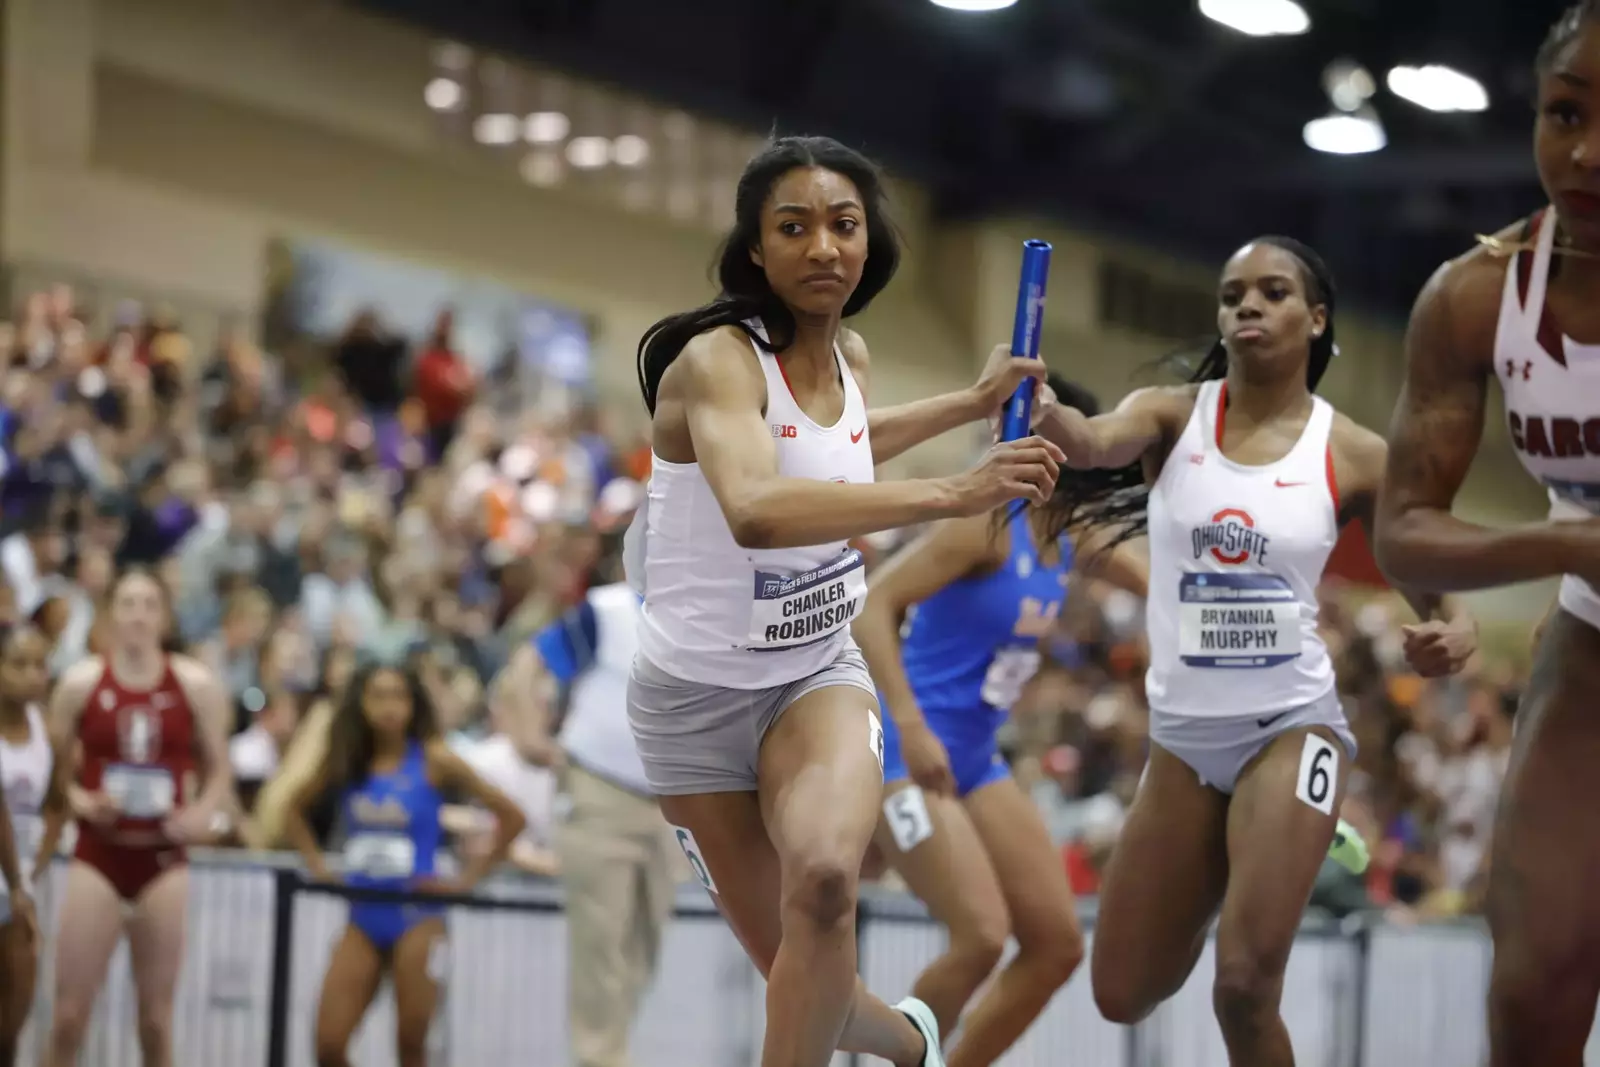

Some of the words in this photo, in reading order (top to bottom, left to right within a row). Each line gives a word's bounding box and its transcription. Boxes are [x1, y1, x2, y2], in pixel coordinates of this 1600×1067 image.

[801, 572, 817, 585] FIELD
[782, 581, 846, 618] CHANLER
[1201, 609, 1276, 625] BRYANNIA
[765, 598, 857, 642] ROBINSON
[1201, 630, 1278, 649] MURPHY
[1308, 747, 1332, 803] 6
[893, 795, 920, 844] 5
[675, 829, 710, 887] 6
